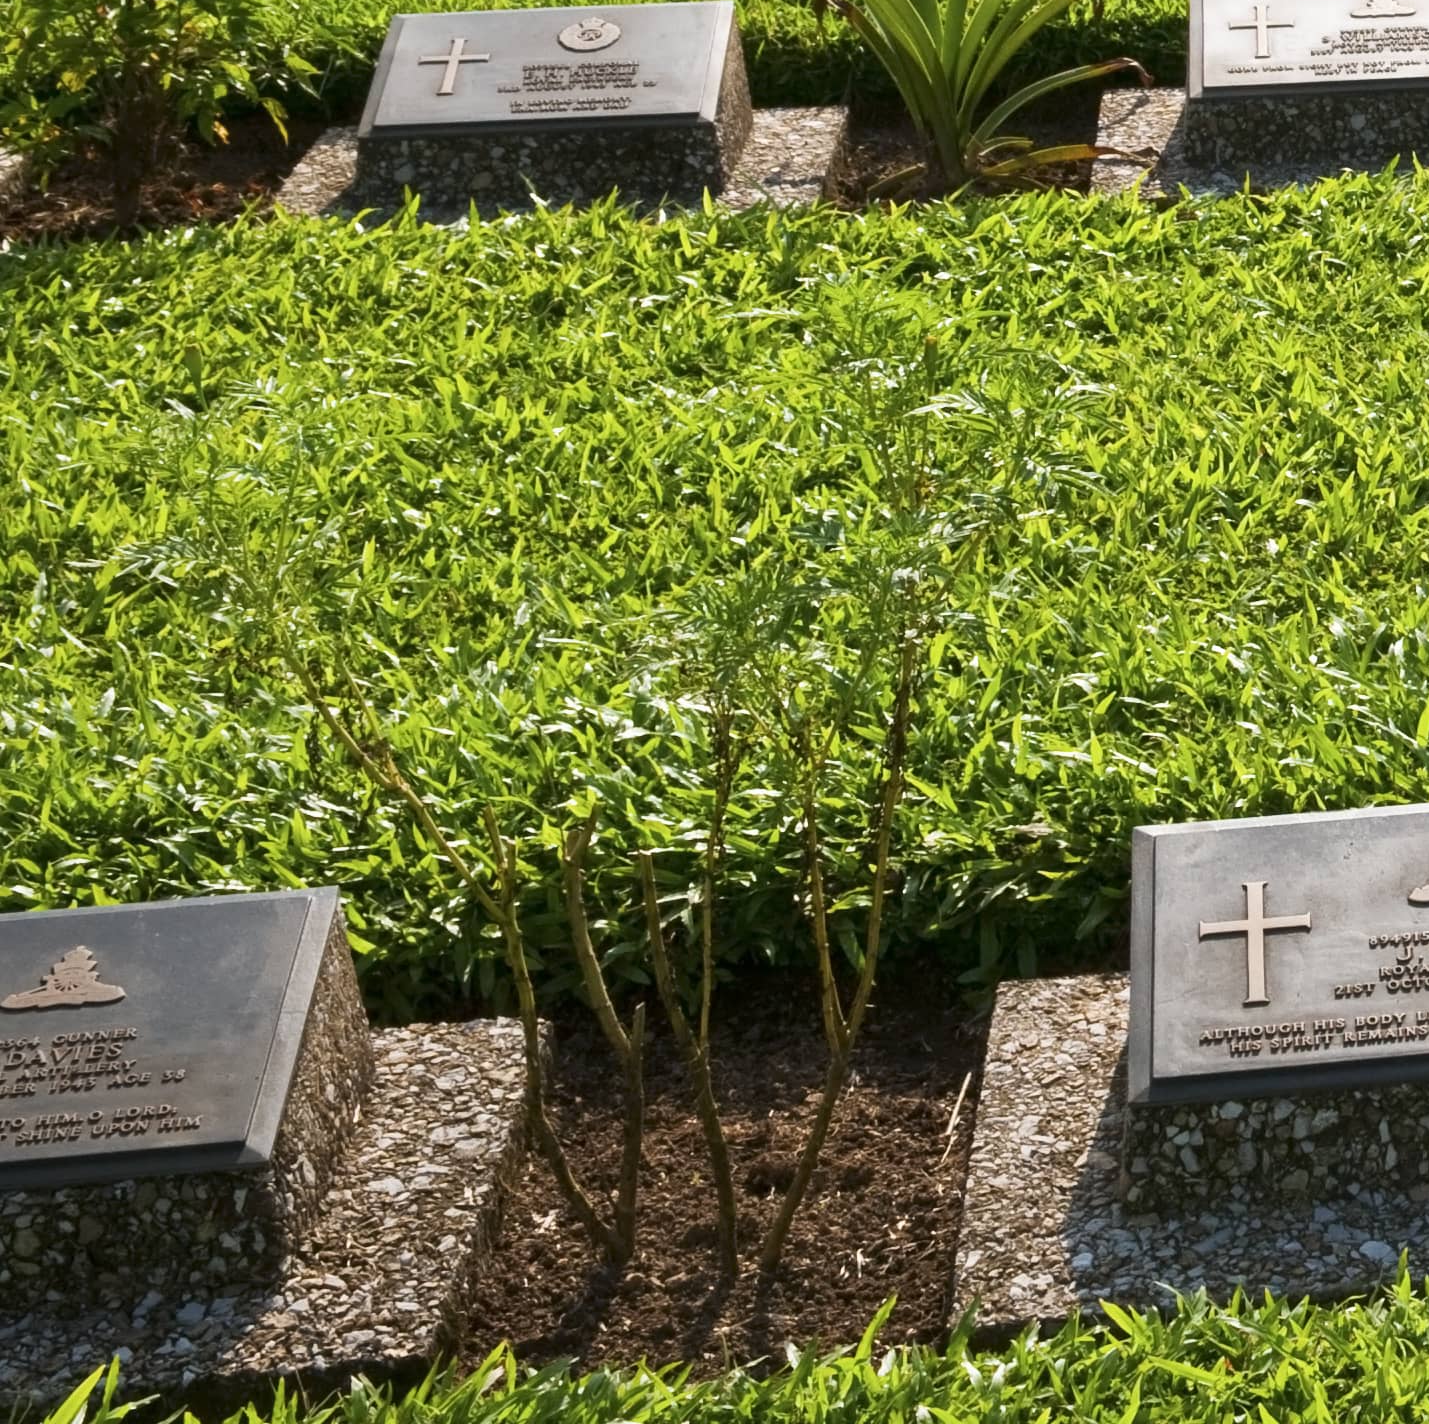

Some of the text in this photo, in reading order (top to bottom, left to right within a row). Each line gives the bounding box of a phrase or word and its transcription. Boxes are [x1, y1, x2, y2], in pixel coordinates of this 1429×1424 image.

[1334, 982, 1376, 999] 21ST
[52, 1027, 138, 1049] GUNNER
[1199, 1022, 1306, 1046] ALTHOUGH
[1314, 1017, 1346, 1034] HIS
[1355, 1012, 1407, 1031] BODY
[1230, 1038, 1263, 1058] HIS
[1271, 1034, 1332, 1054] SPIRIT
[1343, 1025, 1429, 1049] REMAINS
[3, 1041, 125, 1072] DAVIES
[16, 1059, 137, 1084] ARTILLERY
[49, 1076, 97, 1096] 1943
[107, 1071, 152, 1090] AGE
[160, 1068, 187, 1085] 38
[15, 1125, 83, 1148] SHINE
[90, 1119, 150, 1141] UPON
[157, 1114, 204, 1134] HIM
[88, 1109, 105, 1125] O
